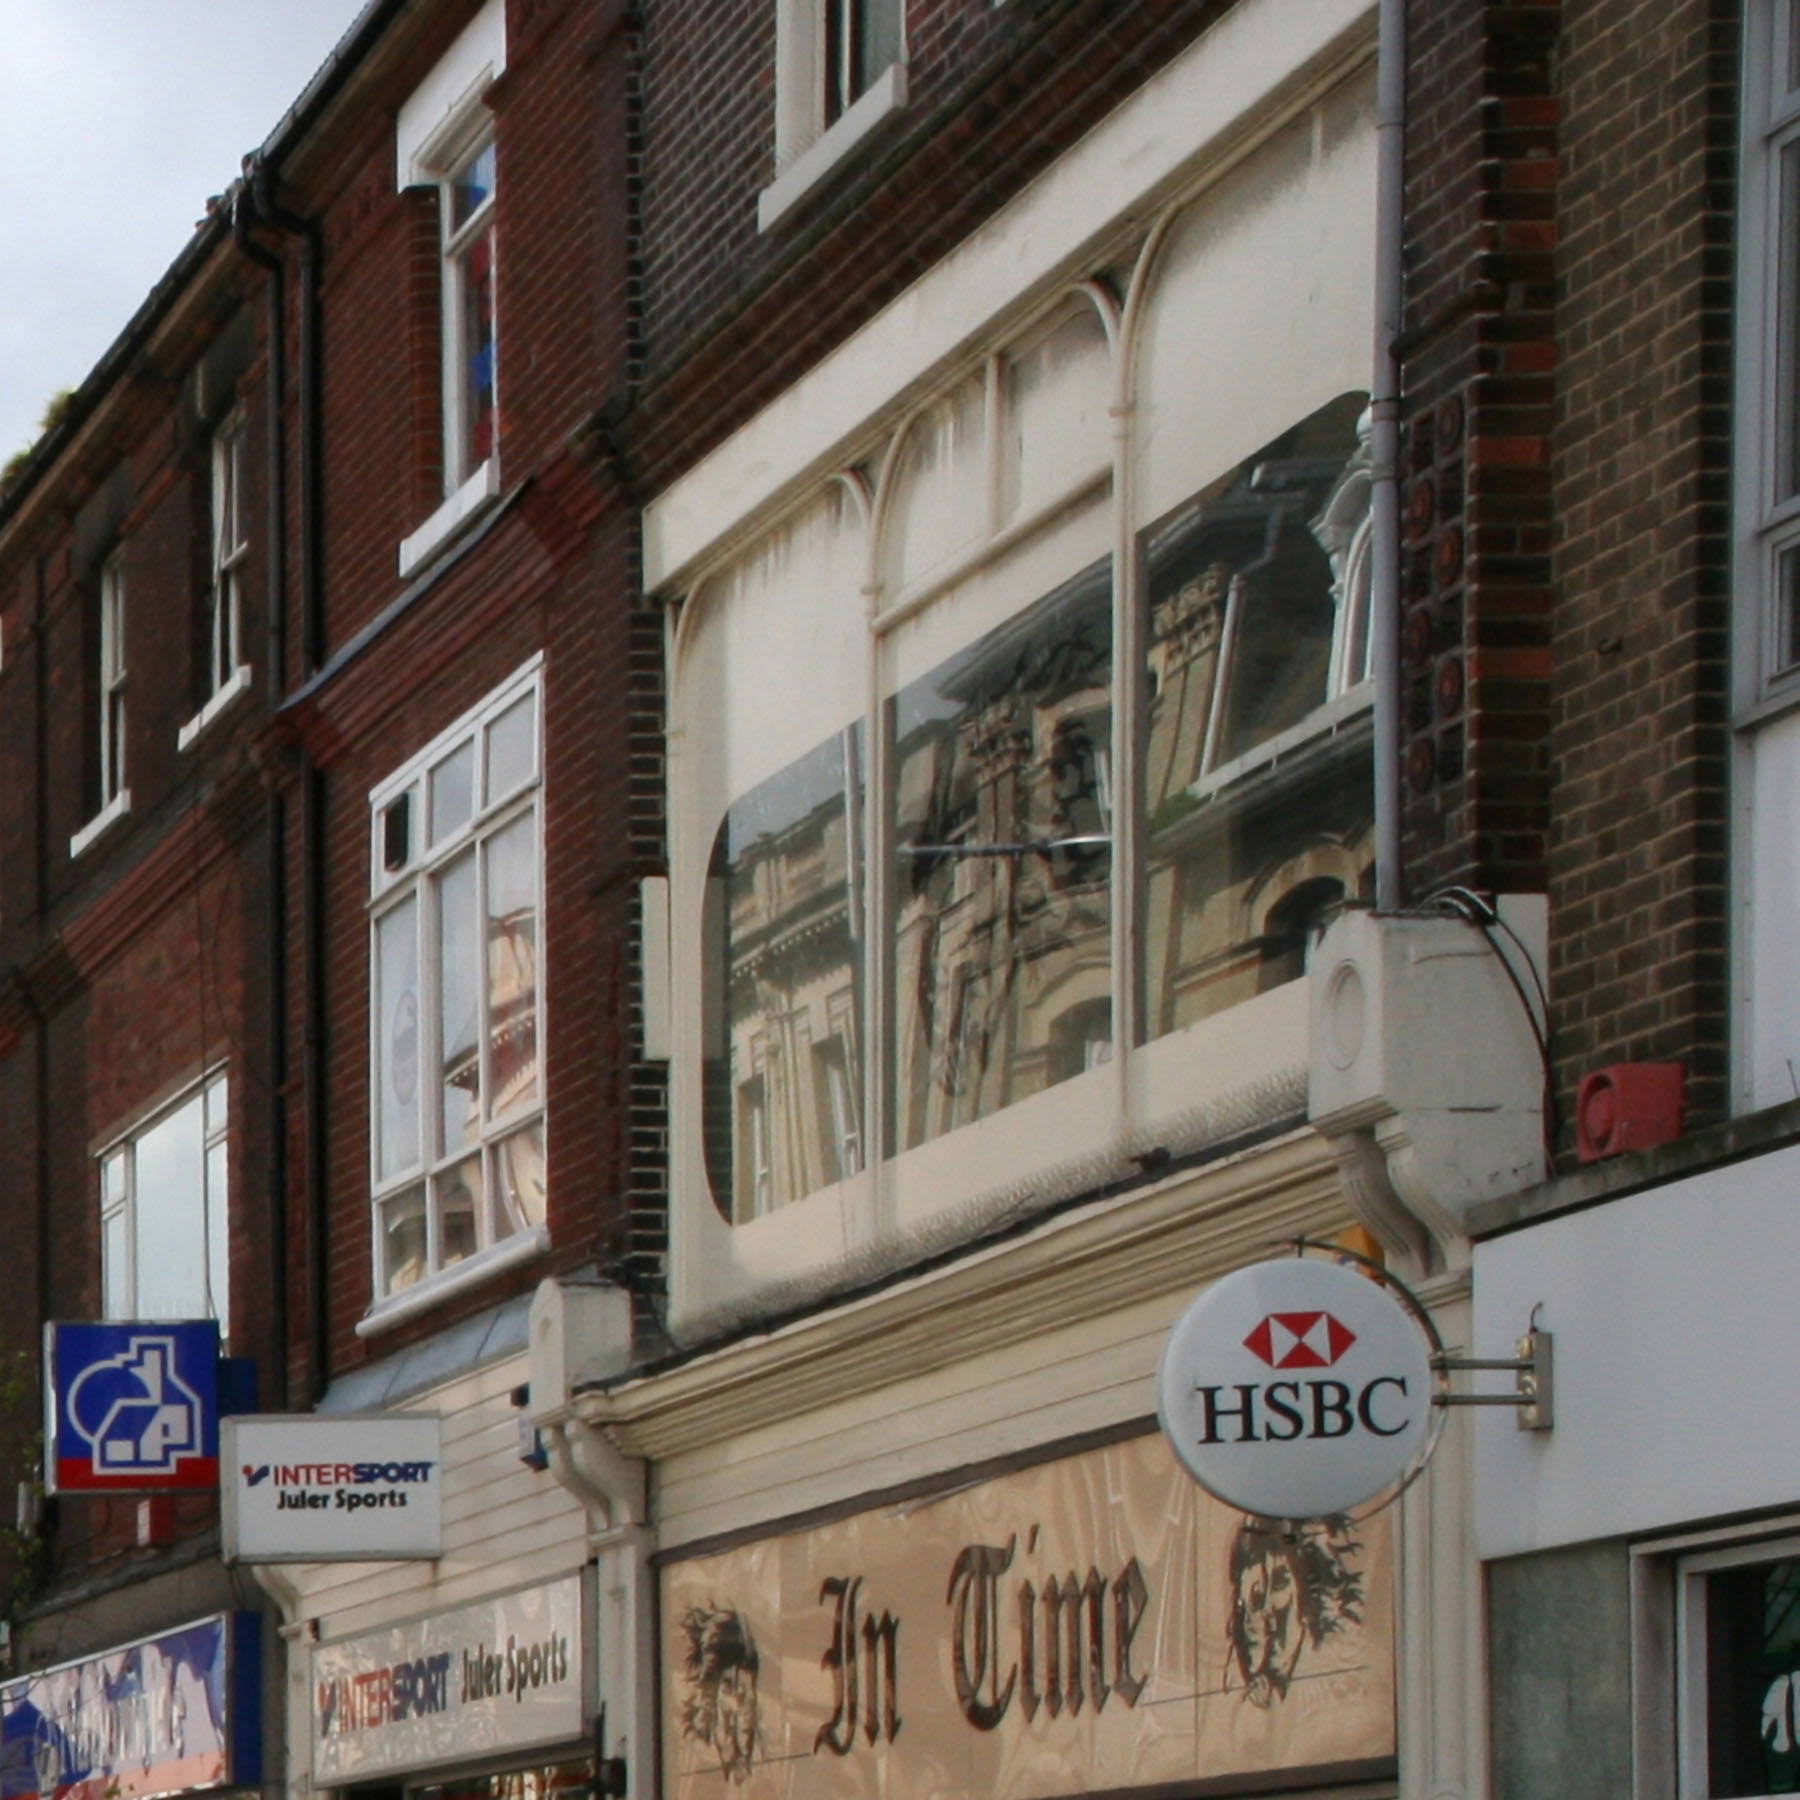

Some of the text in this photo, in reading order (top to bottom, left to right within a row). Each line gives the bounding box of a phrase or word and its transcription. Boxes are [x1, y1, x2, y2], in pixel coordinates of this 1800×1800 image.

[1196, 1376, 1410, 1444] HSBC
[274, 1462, 435, 1486] INTERSPORT
[277, 1489, 408, 1512] Juler Sports
[812, 1523, 1150, 1757] In Time
[339, 1631, 568, 1734] INTERSPORT Juler Sports
